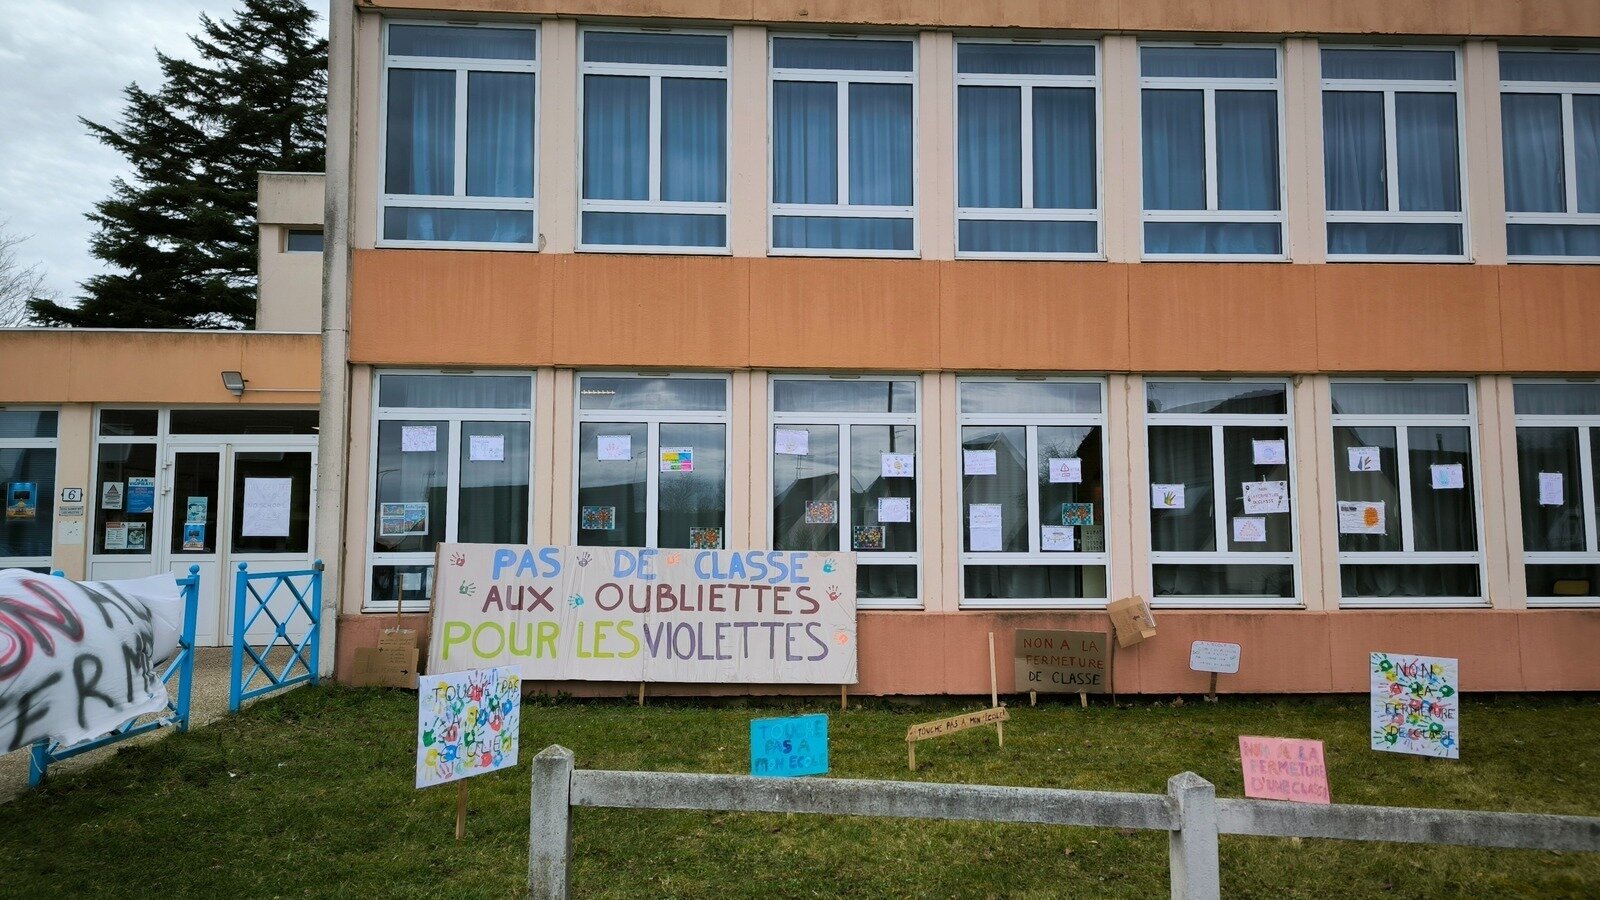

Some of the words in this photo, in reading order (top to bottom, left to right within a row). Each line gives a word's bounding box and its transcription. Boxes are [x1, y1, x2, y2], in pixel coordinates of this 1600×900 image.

[68, 489, 77, 500] 6
[492, 547, 561, 580] PAS
[613, 549, 659, 580] DE
[694, 551, 809, 584] CLASSE
[481, 585, 555, 613] AUX
[595, 582, 820, 615] OUBLIETTES
[442, 621, 560, 661] POUR
[576, 620, 640, 660] LES
[644, 621, 829, 662] VIOLETTES
[1023, 638, 1053, 649] NON
[1060, 640, 1070, 650] A
[1082, 641, 1099, 652] LA
[1026, 654, 1104, 669] FERMETURE
[1029, 671, 1042, 682] DE
[1052, 671, 1101, 685] CLASSE
[1395, 661, 1433, 680] NON
[1416, 684, 1433, 697] LA
[1385, 702, 1455, 720] FERMETURE
[918, 724, 942, 737] TOUCHE
[946, 720, 958, 731] PAS
[960, 718, 967, 727] A
[970, 716, 981, 724] MON
[765, 739, 793, 755] PAS
[797, 739, 811, 753] A
[1298, 745, 1319, 762] LA
[754, 757, 785, 772] MON
[1250, 759, 1326, 778] FERMETURE
